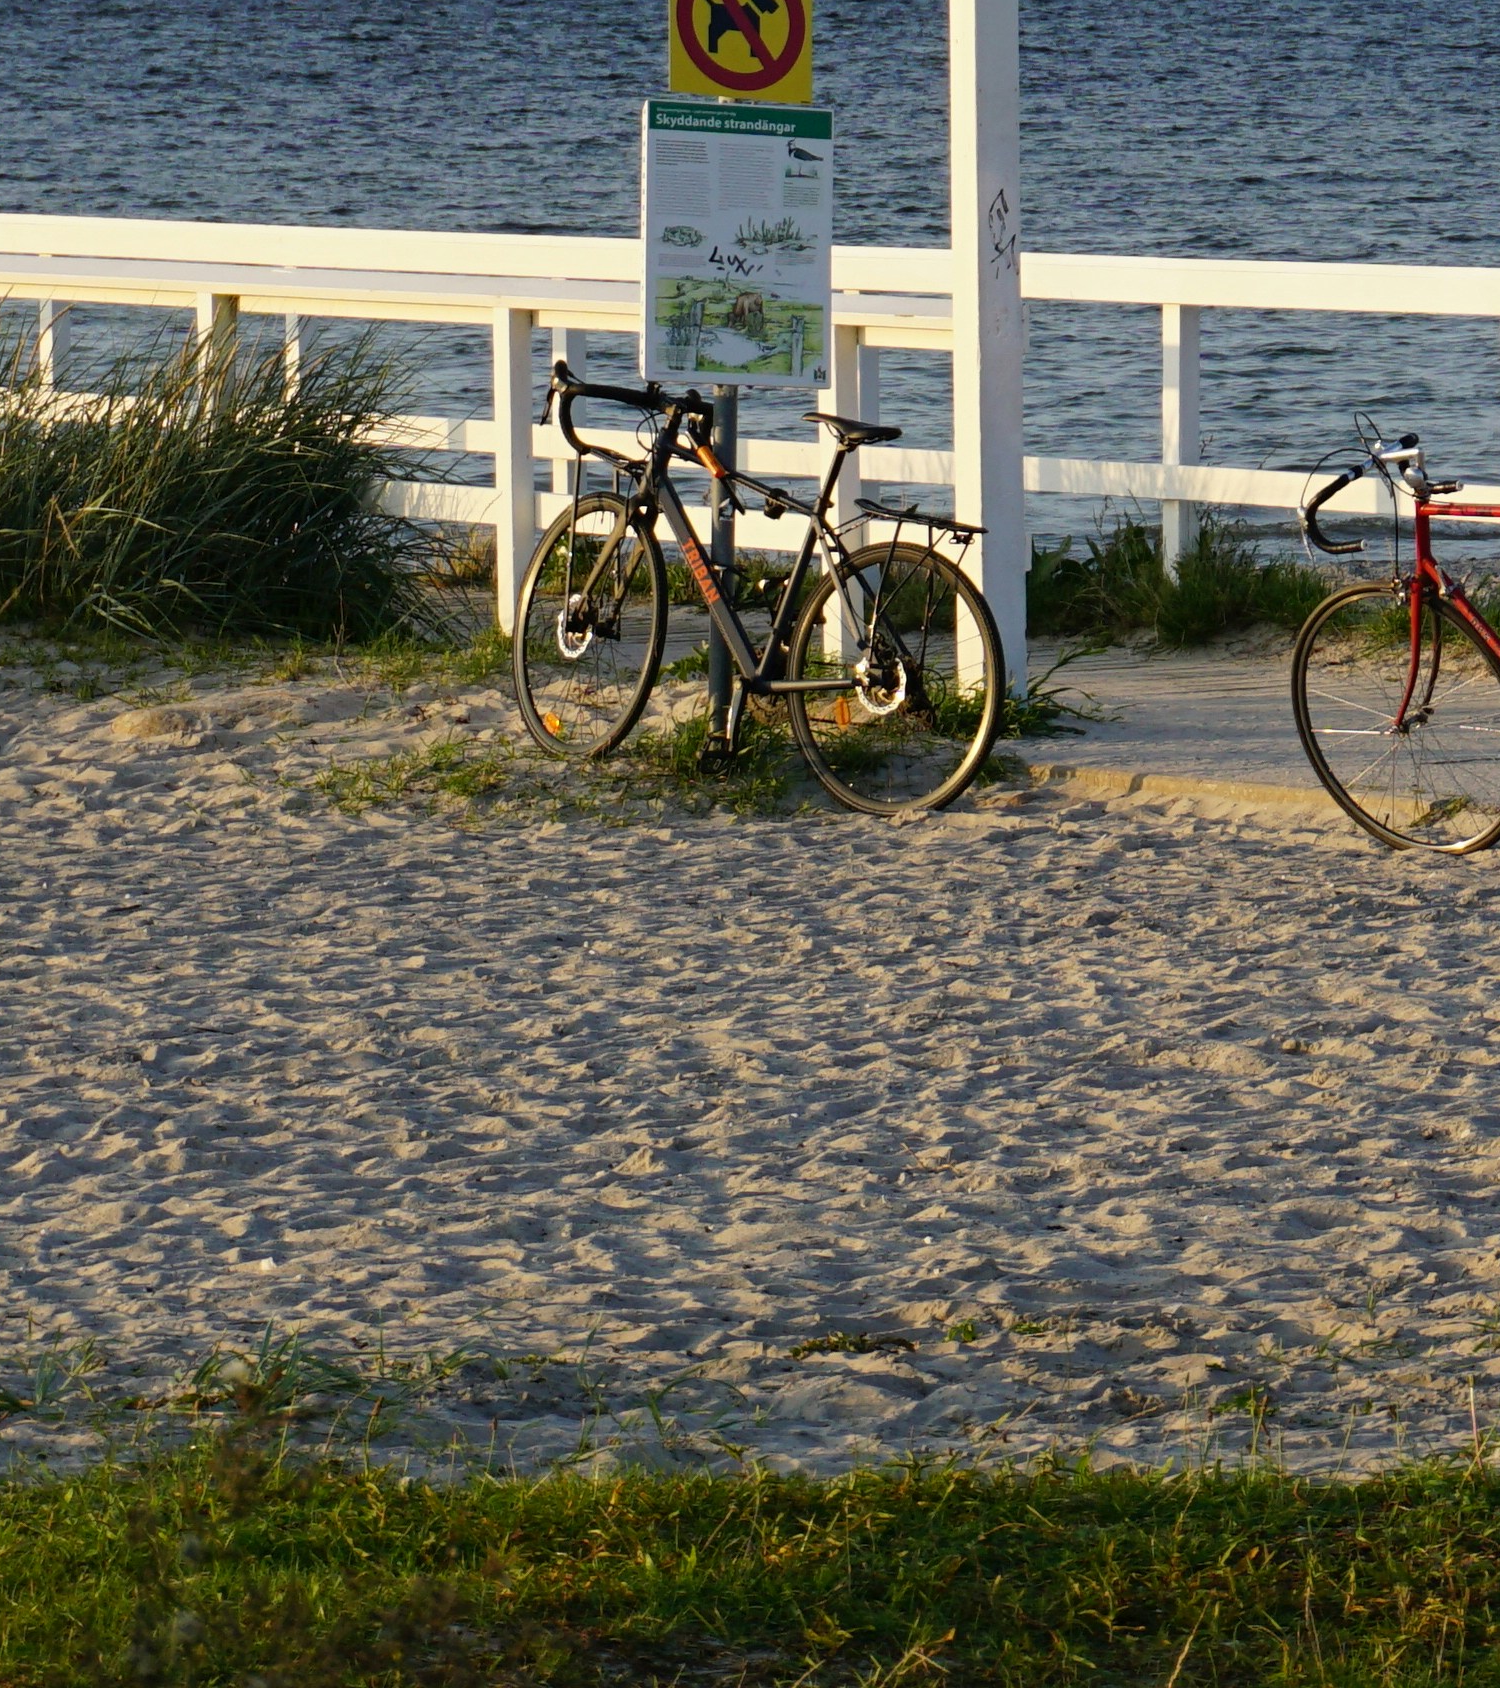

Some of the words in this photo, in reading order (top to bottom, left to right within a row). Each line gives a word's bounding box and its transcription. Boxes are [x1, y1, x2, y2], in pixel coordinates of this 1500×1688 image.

[655, 113, 722, 128] Skyddande
[723, 118, 797, 134] strandängar
[681, 536, 720, 604] TRIBAN
